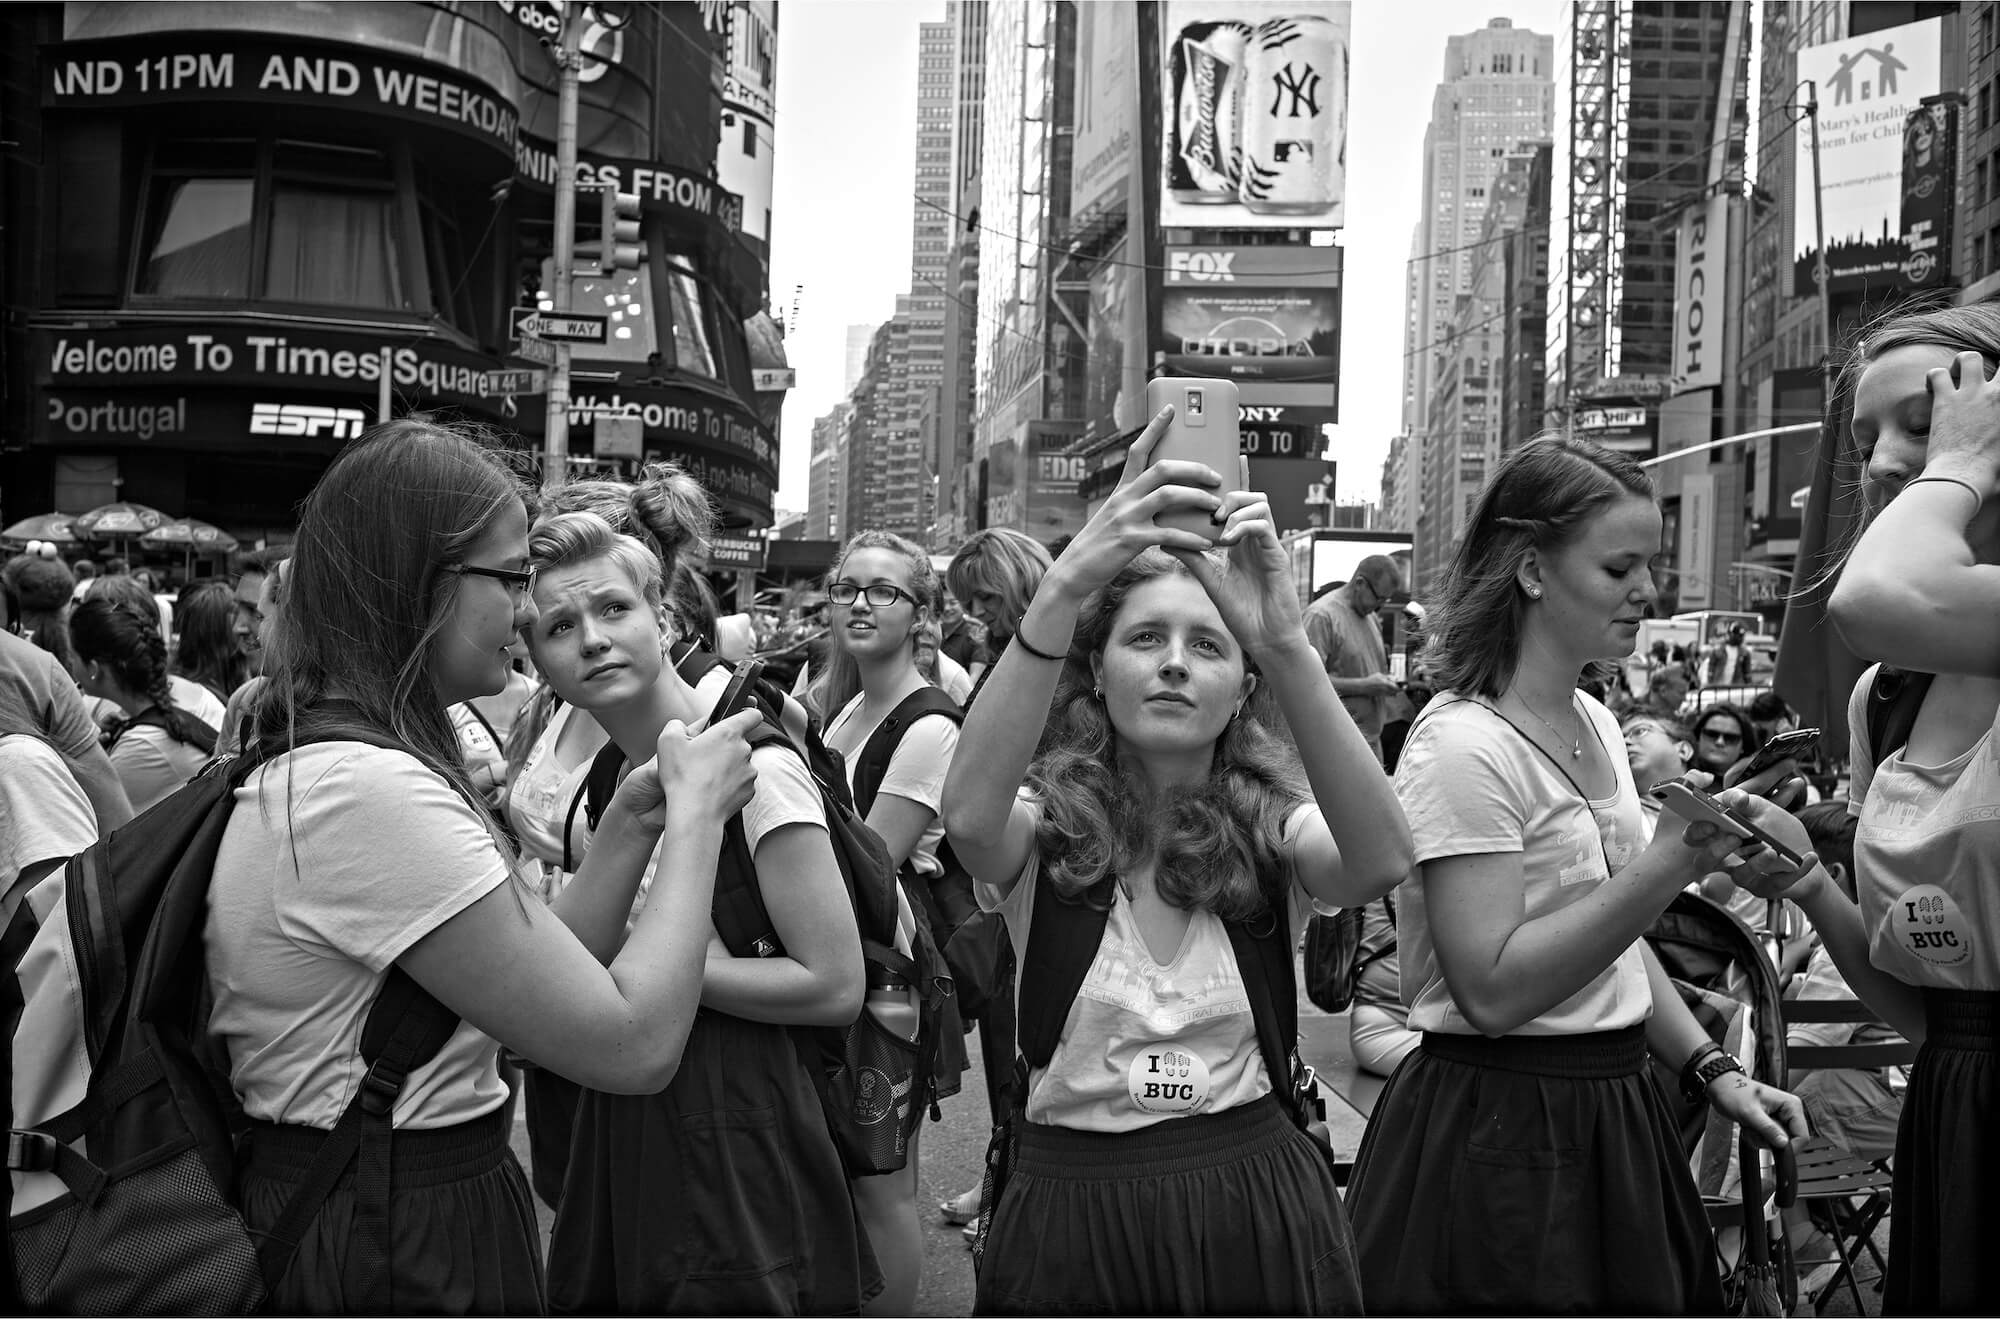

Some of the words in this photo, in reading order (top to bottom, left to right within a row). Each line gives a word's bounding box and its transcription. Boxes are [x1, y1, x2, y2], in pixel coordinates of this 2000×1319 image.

[519, 4, 560, 33] abc
[135, 53, 234, 92] 11PM
[258, 55, 360, 97] AND
[372, 66, 518, 146] WEEKDAY
[1270, 61, 1321, 118] NY
[1820, 115, 1860, 133] Mary's
[1850, 130, 1869, 144] for
[633, 168, 711, 216] FROM
[1170, 252, 1236, 282] FOX
[1686, 214, 1707, 374] RICOH
[526, 318, 553, 335] ONE
[567, 320, 595, 336] WAY
[1181, 337, 1316, 357] UTOPIA
[187, 335, 234, 372] To
[246, 336, 380, 381] Times
[393, 349, 488, 398] Square
[490, 376, 500, 392] W
[502, 374, 517, 392] 44
[249, 403, 366, 440] ESPN
[703, 407, 721, 438] To
[1269, 430, 1293, 454] TO
[714, 550, 750, 561] COFFEE
[1905, 901, 1918, 923] I
[1909, 930, 1959, 949] BUC
[1147, 1054, 1160, 1073] I
[1143, 1082, 1193, 1101] BUC
